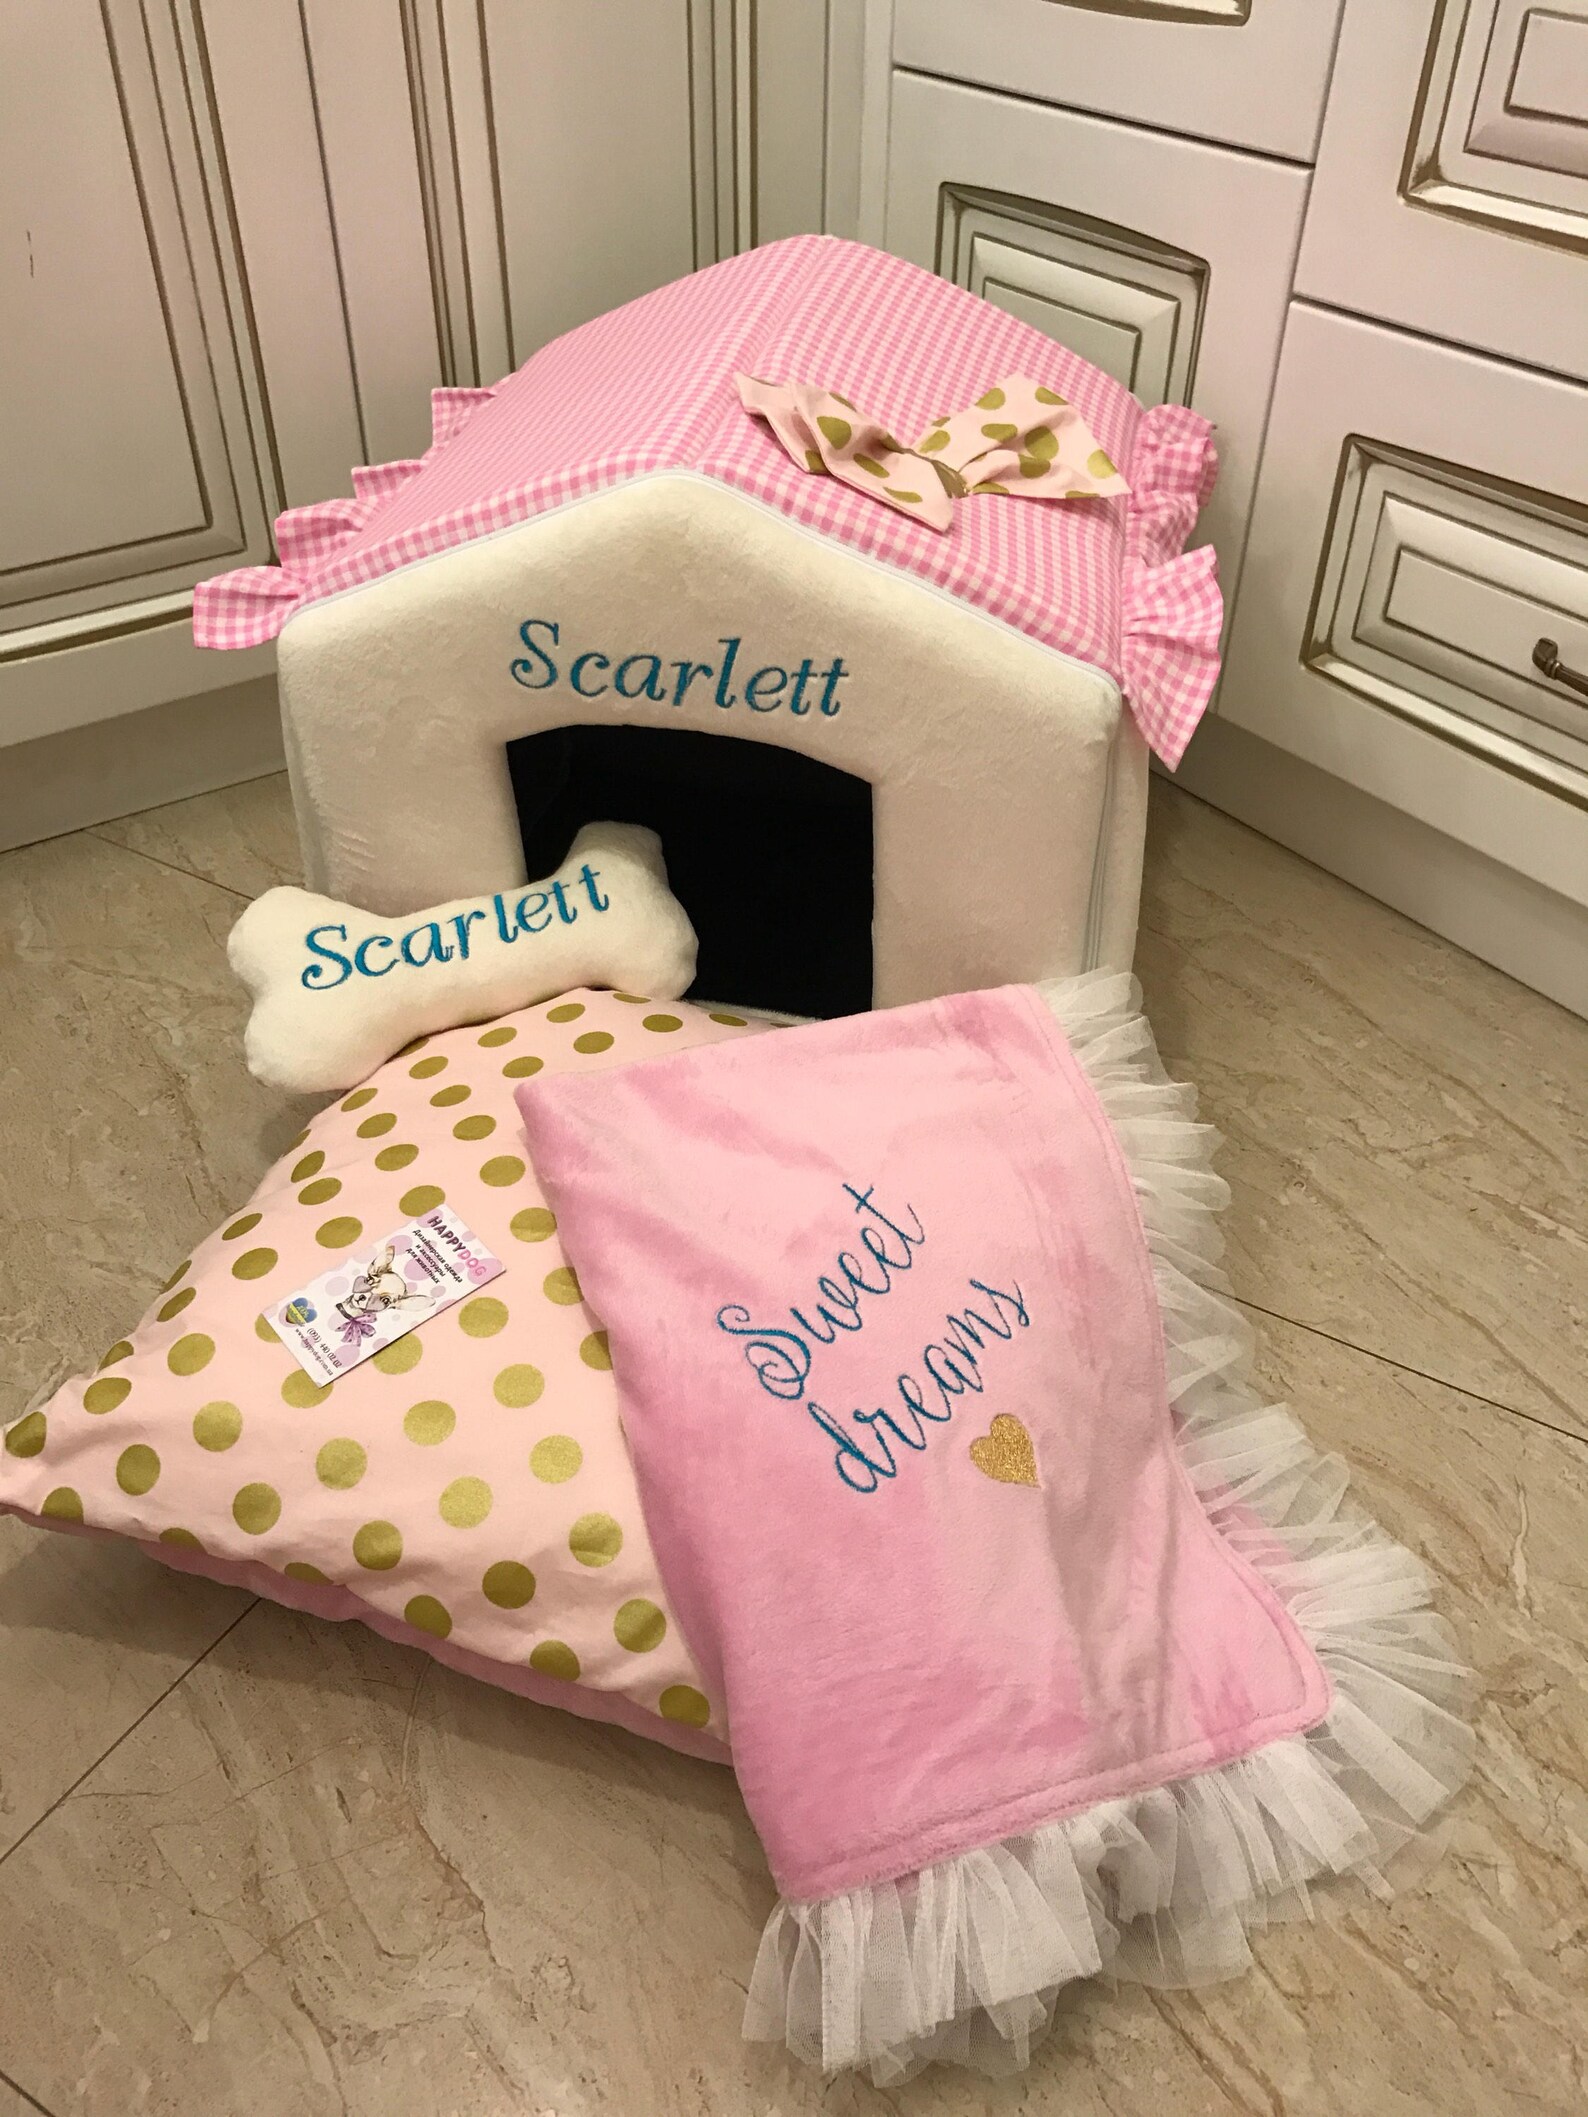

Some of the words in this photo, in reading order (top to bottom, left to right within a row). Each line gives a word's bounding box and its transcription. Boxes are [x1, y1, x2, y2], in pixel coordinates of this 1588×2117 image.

[509, 619, 850, 717] Scarlett
[301, 864, 609, 990] Scarlett
[412, 1229, 446, 1264] Дизайнерская
[444, 1263, 463, 1283] одежда
[419, 1248, 446, 1277] аксессуары
[427, 1215, 487, 1277] HAPPYDOG
[716, 1183, 925, 1400] Sweet
[808, 1278, 1029, 1493] dreams
